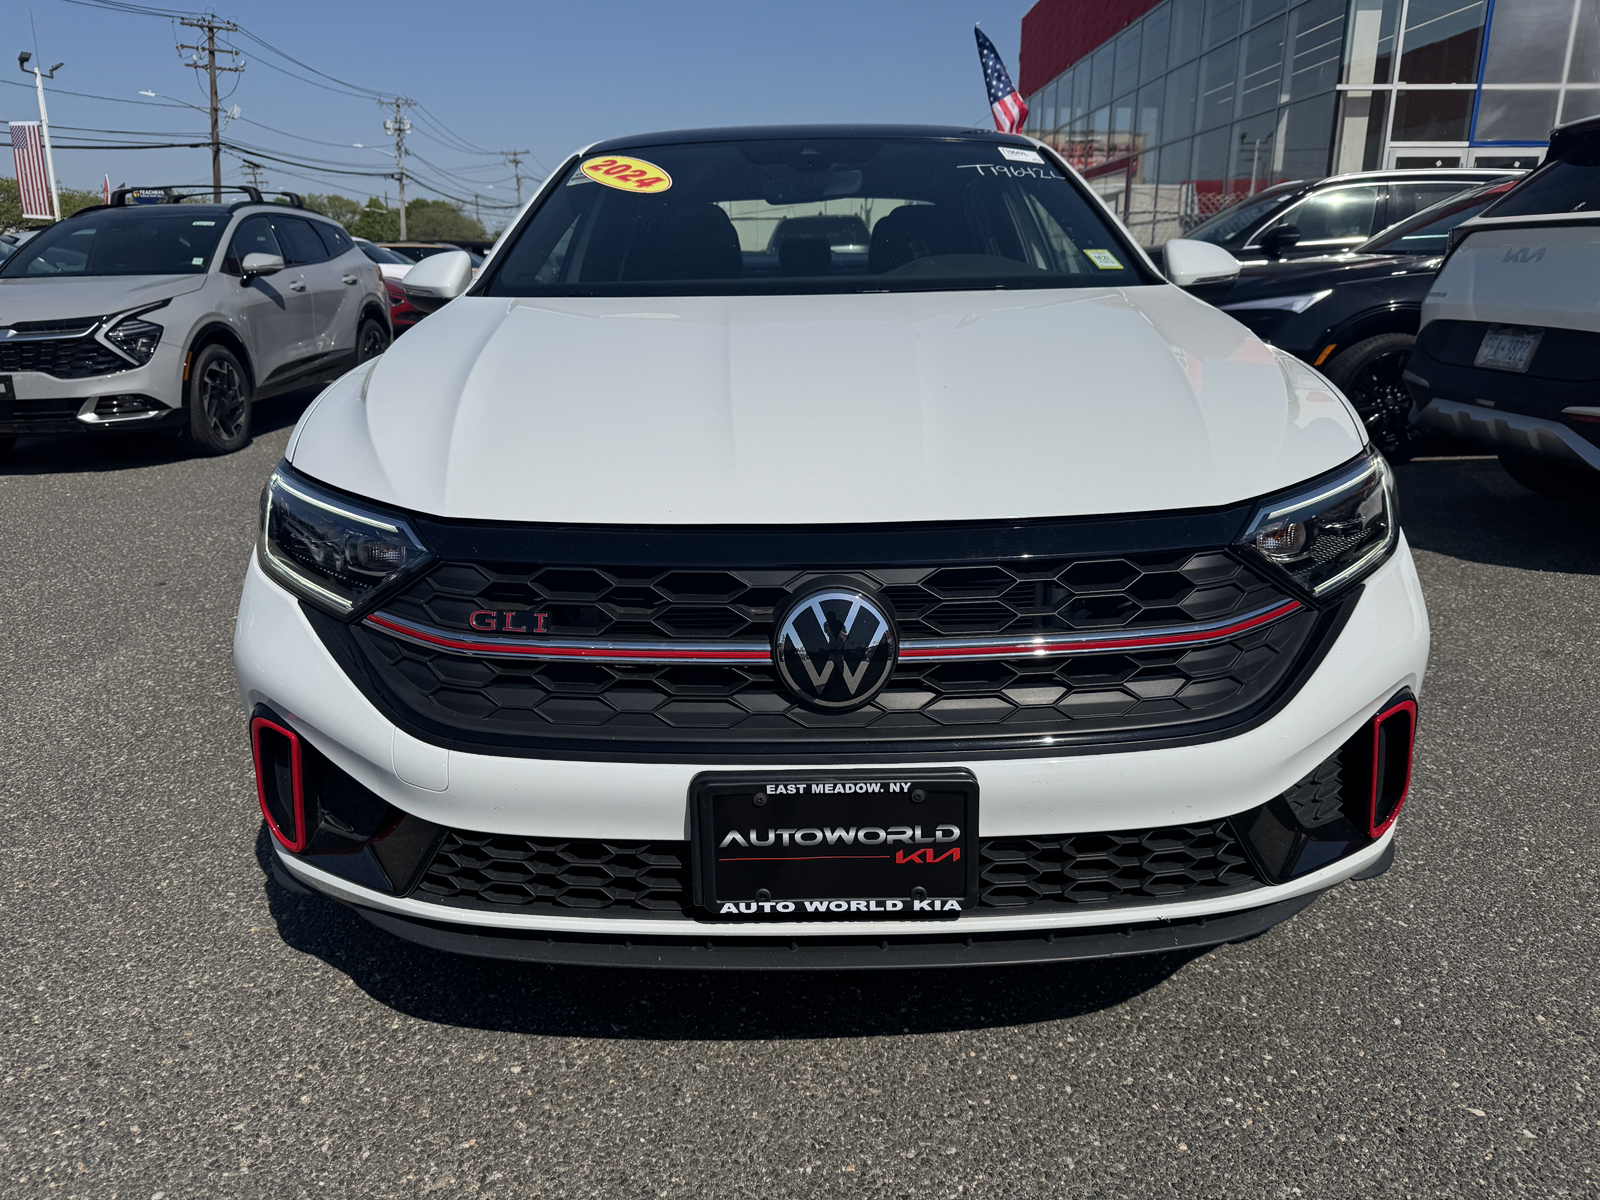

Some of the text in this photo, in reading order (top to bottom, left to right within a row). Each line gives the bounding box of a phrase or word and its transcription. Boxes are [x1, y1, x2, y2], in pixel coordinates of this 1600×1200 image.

[585, 160, 665, 188] 2024
[469, 610, 548, 633] GLI
[766, 784, 806, 795] EAST
[889, 782, 911, 793] NY
[719, 824, 961, 848] AUTOWORLD
[895, 847, 961, 864] KIA
[720, 899, 962, 914] AUTO WORLD KIA
